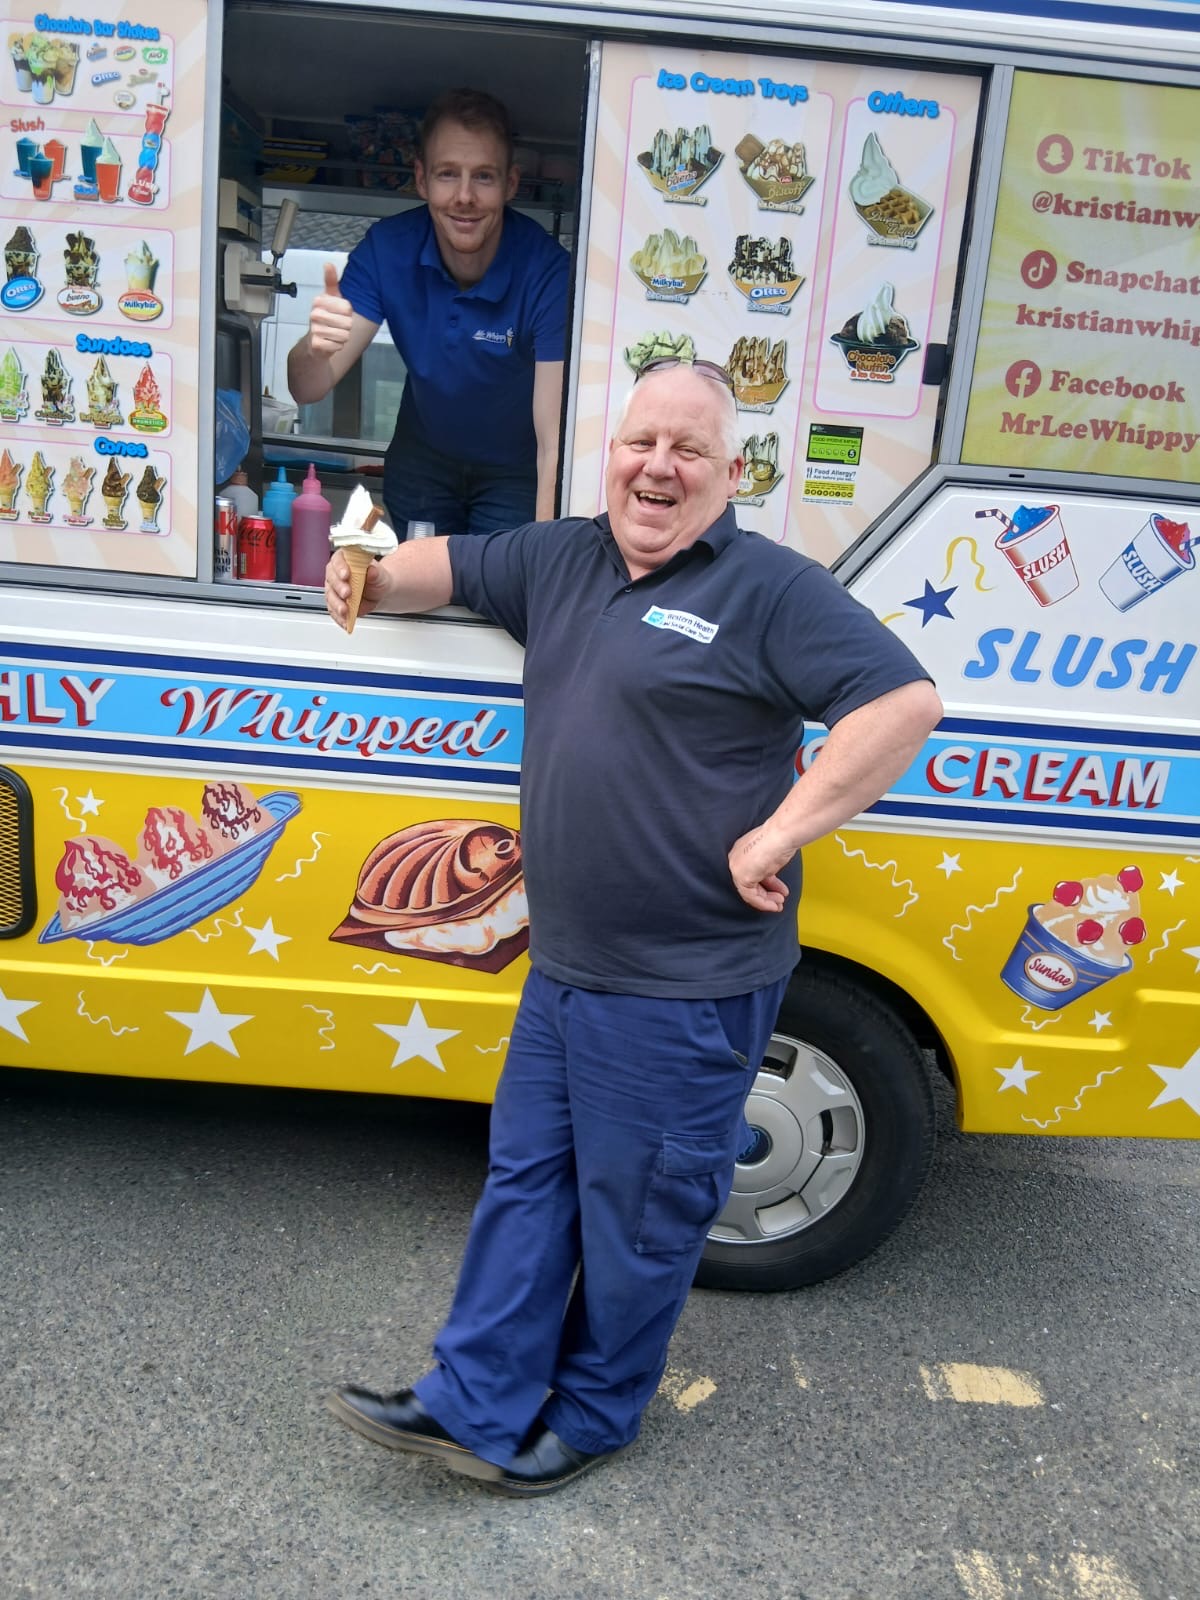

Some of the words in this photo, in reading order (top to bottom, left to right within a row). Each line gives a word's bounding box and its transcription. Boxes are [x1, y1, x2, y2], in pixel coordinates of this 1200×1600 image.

[93, 19, 115, 37] Bar
[117, 20, 160, 42] Shakes
[657, 68, 686, 90] Ice
[690, 72, 755, 97] Cream
[758, 78, 809, 106] Trays
[867, 90, 940, 118] Others
[10, 116, 46, 133] Slush
[1083, 147, 1192, 181] TikTok
[1032, 190, 1200, 229] @kristianw
[652, 279, 685, 288] Milkybar
[1065, 260, 1200, 297] Snapchat
[123, 300, 157, 309] Milkybar
[751, 288, 787, 299] OREO
[76, 333, 152, 357] Sundaes
[847, 350, 896, 364] Chocolate
[1049, 370, 1186, 403] Facebook
[94, 436, 148, 457] Cones
[999, 412, 1200, 453] MrLeeWhippy
[831, 469, 857, 477] Allergy?
[1022, 542, 1068, 581] SLUSH
[1122, 550, 1161, 594] SLUSH
[693, 620, 715, 634] Health
[963, 628, 1198, 694] SLUSH
[160, 684, 511, 757] Whipped
[926, 746, 1171, 809] CREAM
[1029, 958, 1073, 986] Sundae
